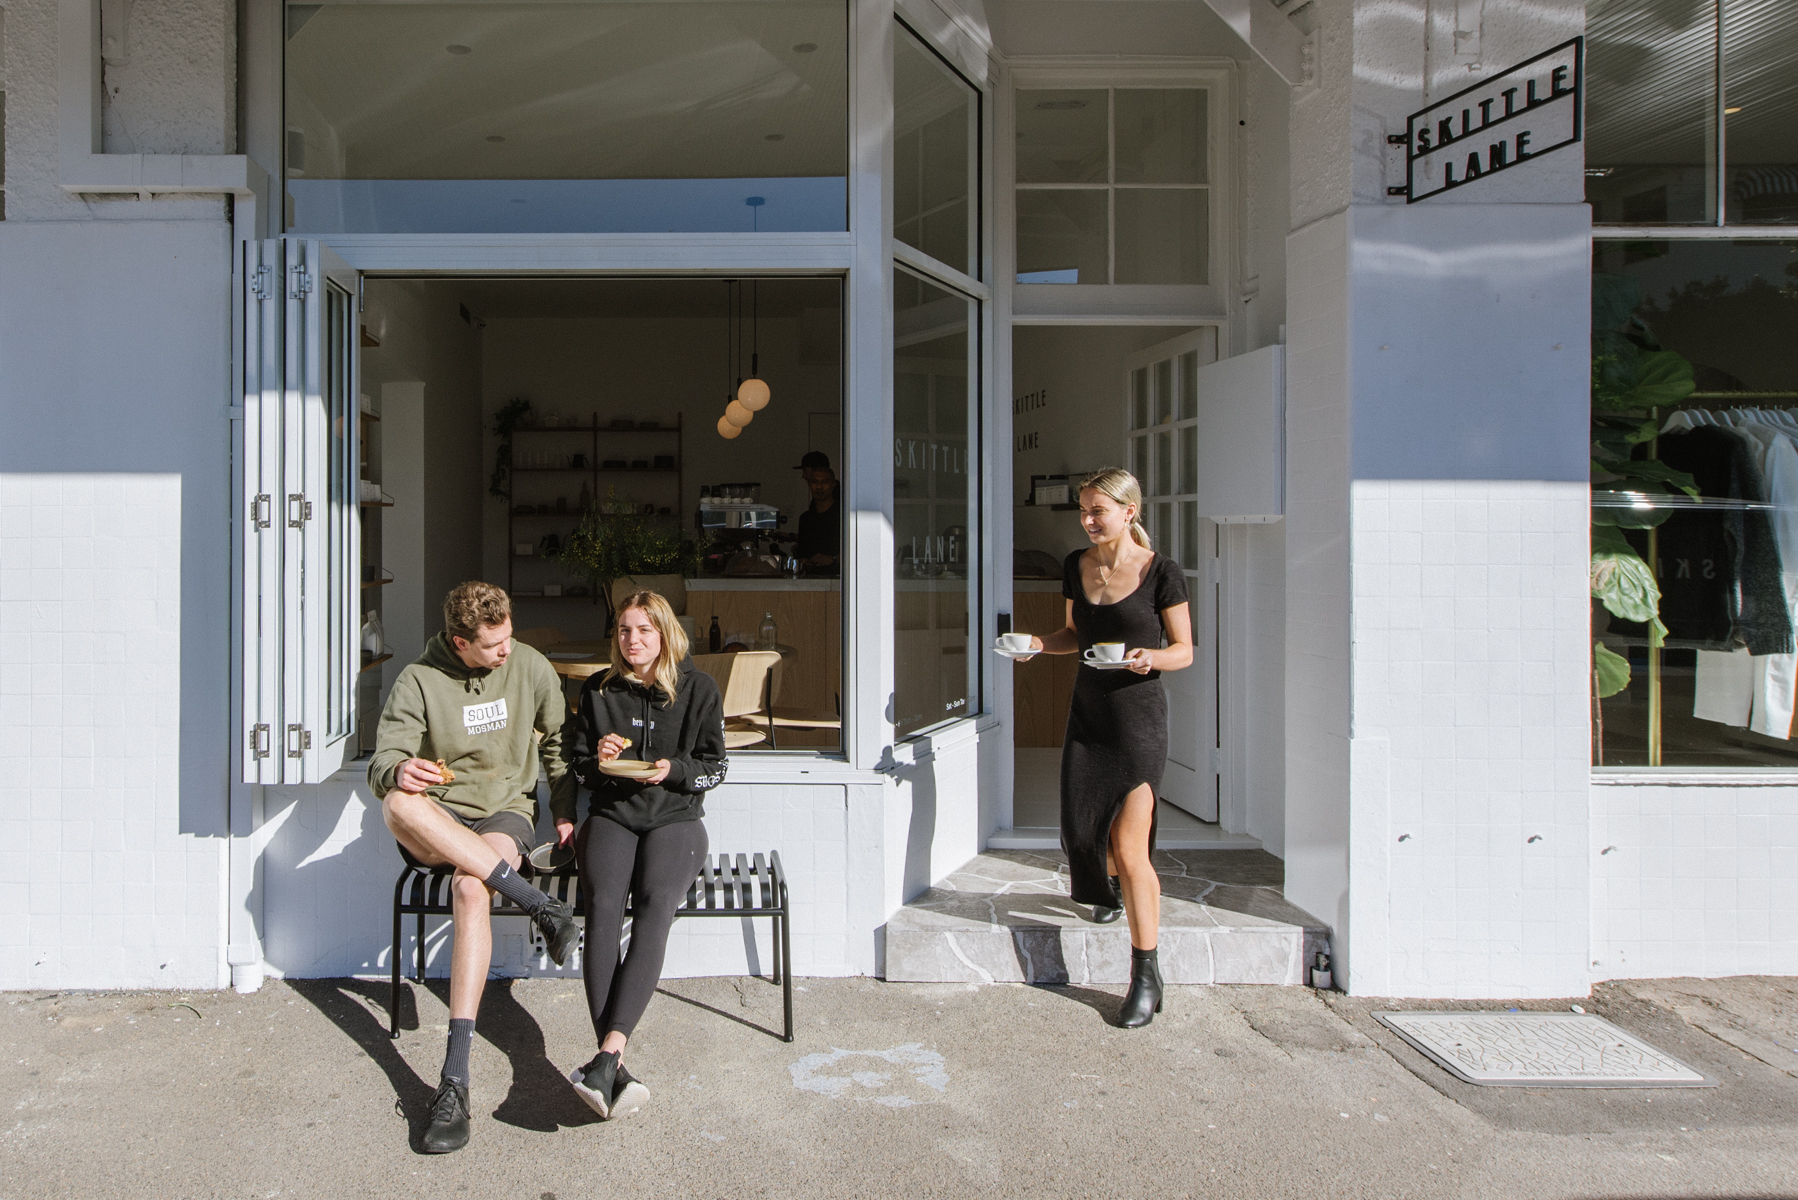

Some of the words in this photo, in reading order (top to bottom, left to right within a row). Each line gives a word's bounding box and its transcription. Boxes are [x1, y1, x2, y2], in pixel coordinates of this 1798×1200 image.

[1417, 65, 1568, 154] SKITTLE
[1445, 131, 1531, 187] LANE
[1017, 432, 1039, 452] LANE
[912, 535, 955, 565] LANE
[468, 704, 504, 722] SOUL
[467, 719, 507, 735] MOSMAN
